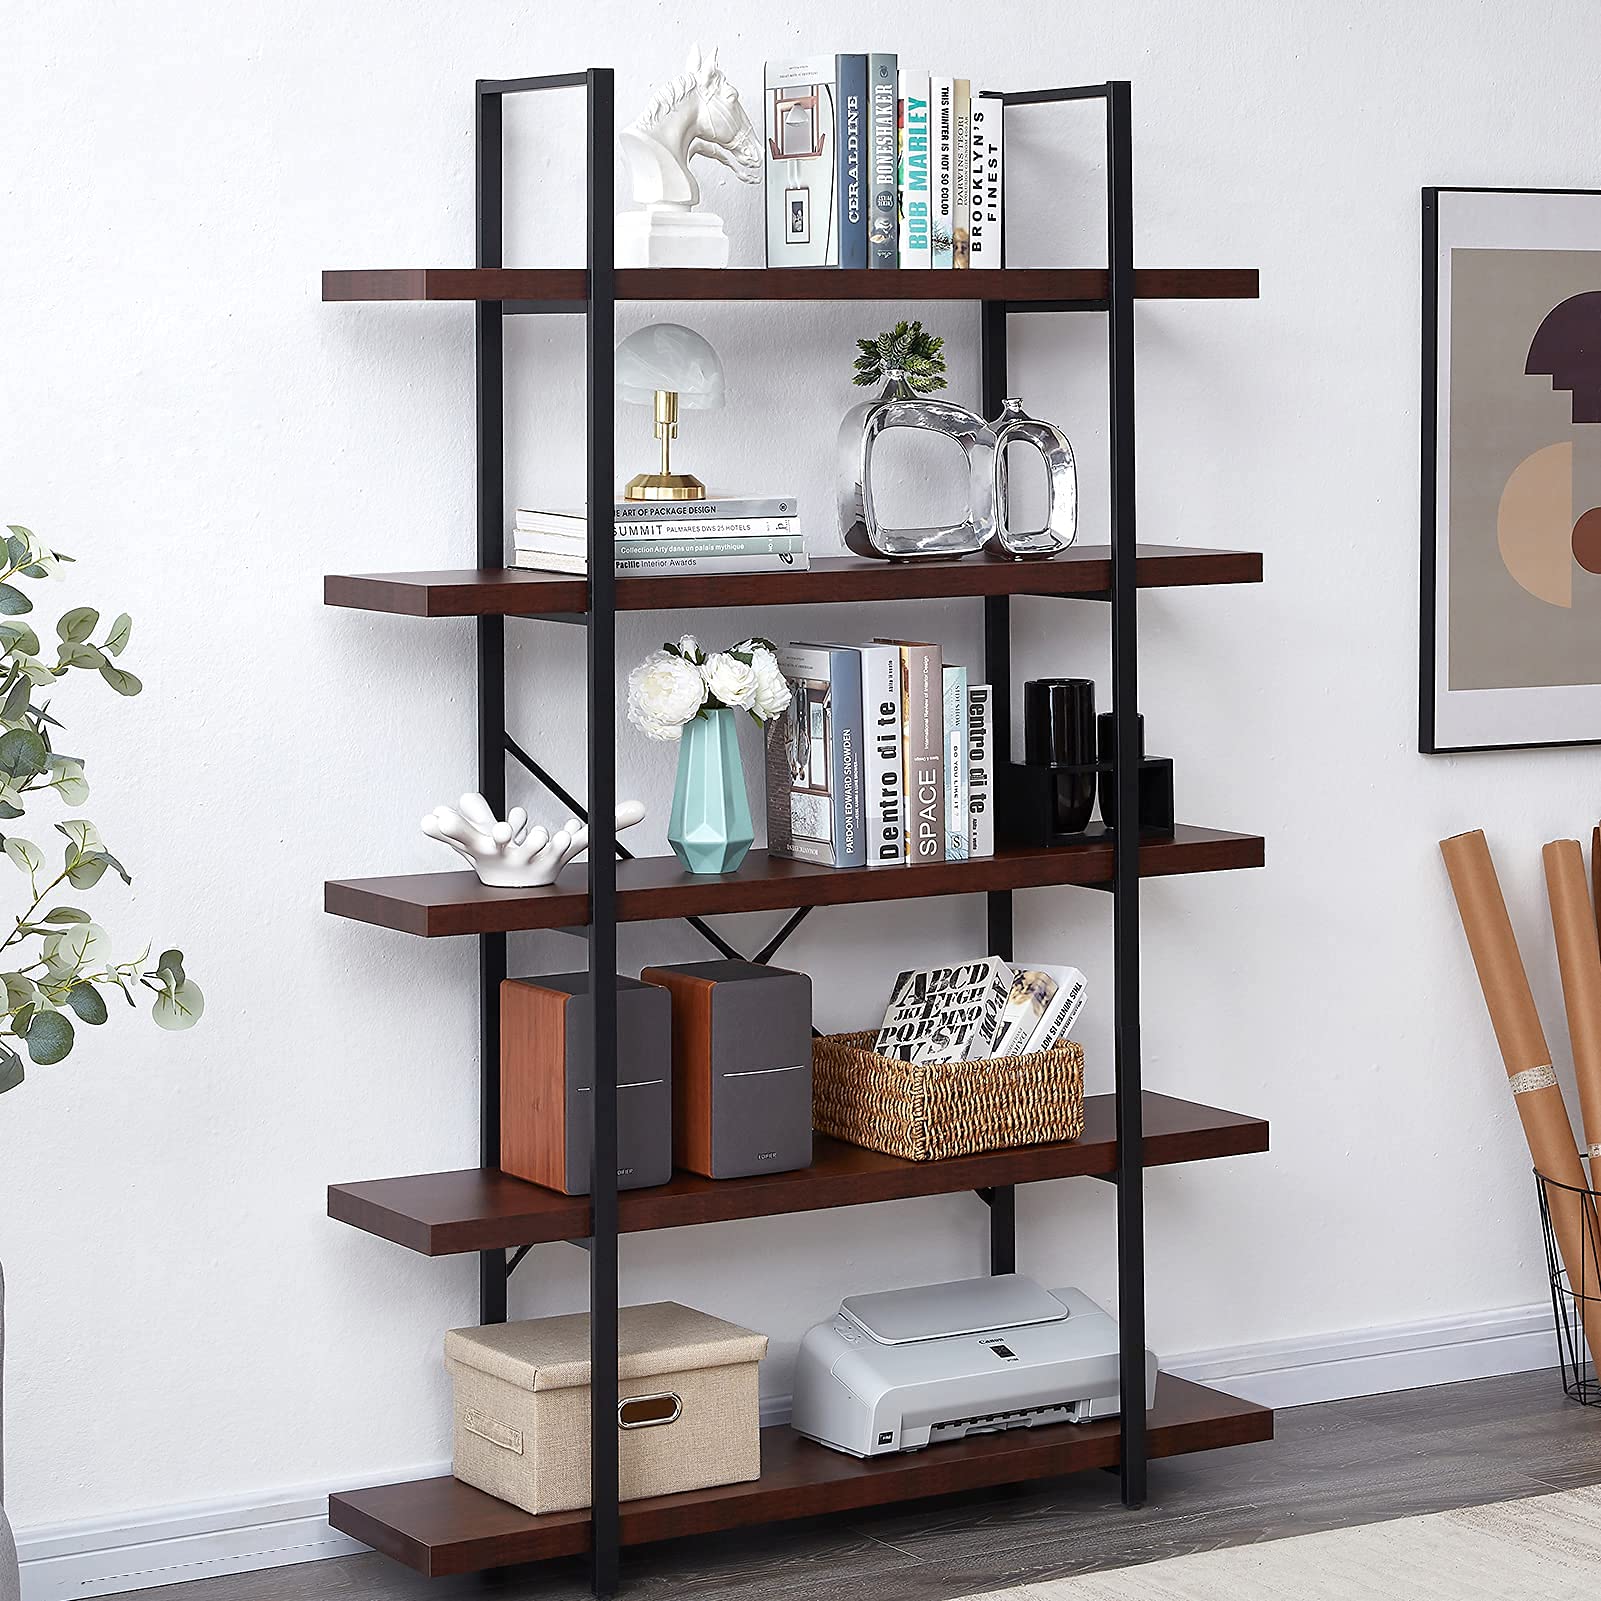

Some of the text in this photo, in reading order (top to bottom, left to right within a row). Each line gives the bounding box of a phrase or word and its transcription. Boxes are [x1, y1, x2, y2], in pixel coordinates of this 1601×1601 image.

[875, 85, 893, 184] BONESHAKER
[908, 97, 928, 249] BOB MARLEY
[940, 87, 949, 215] THIS WINTER IS NOT SO COLOD
[972, 112, 984, 252] BROOKLYN'S
[987, 144, 998, 221] FINEST
[621, 546, 654, 554] Collection
[695, 544, 714, 552] palais
[715, 543, 745, 551] mythique
[622, 509, 636, 517] ART
[638, 508, 648, 516] OF
[650, 507, 687, 516] PACKAGE
[688, 506, 716, 514] DESIGN
[616, 560, 641, 569] Pacific
[641, 560, 668, 568] Interior
[843, 728, 854, 854] PARDON EDWARD SNOWDEN
[877, 702, 899, 859] Dentro di te
[954, 746, 958, 758] DO
[970, 690, 988, 813] Dentro di te
[918, 769, 938, 856] SPACE
[1056, 998, 1074, 1027] WINTER
[1069, 982, 1082, 1000] THIS
